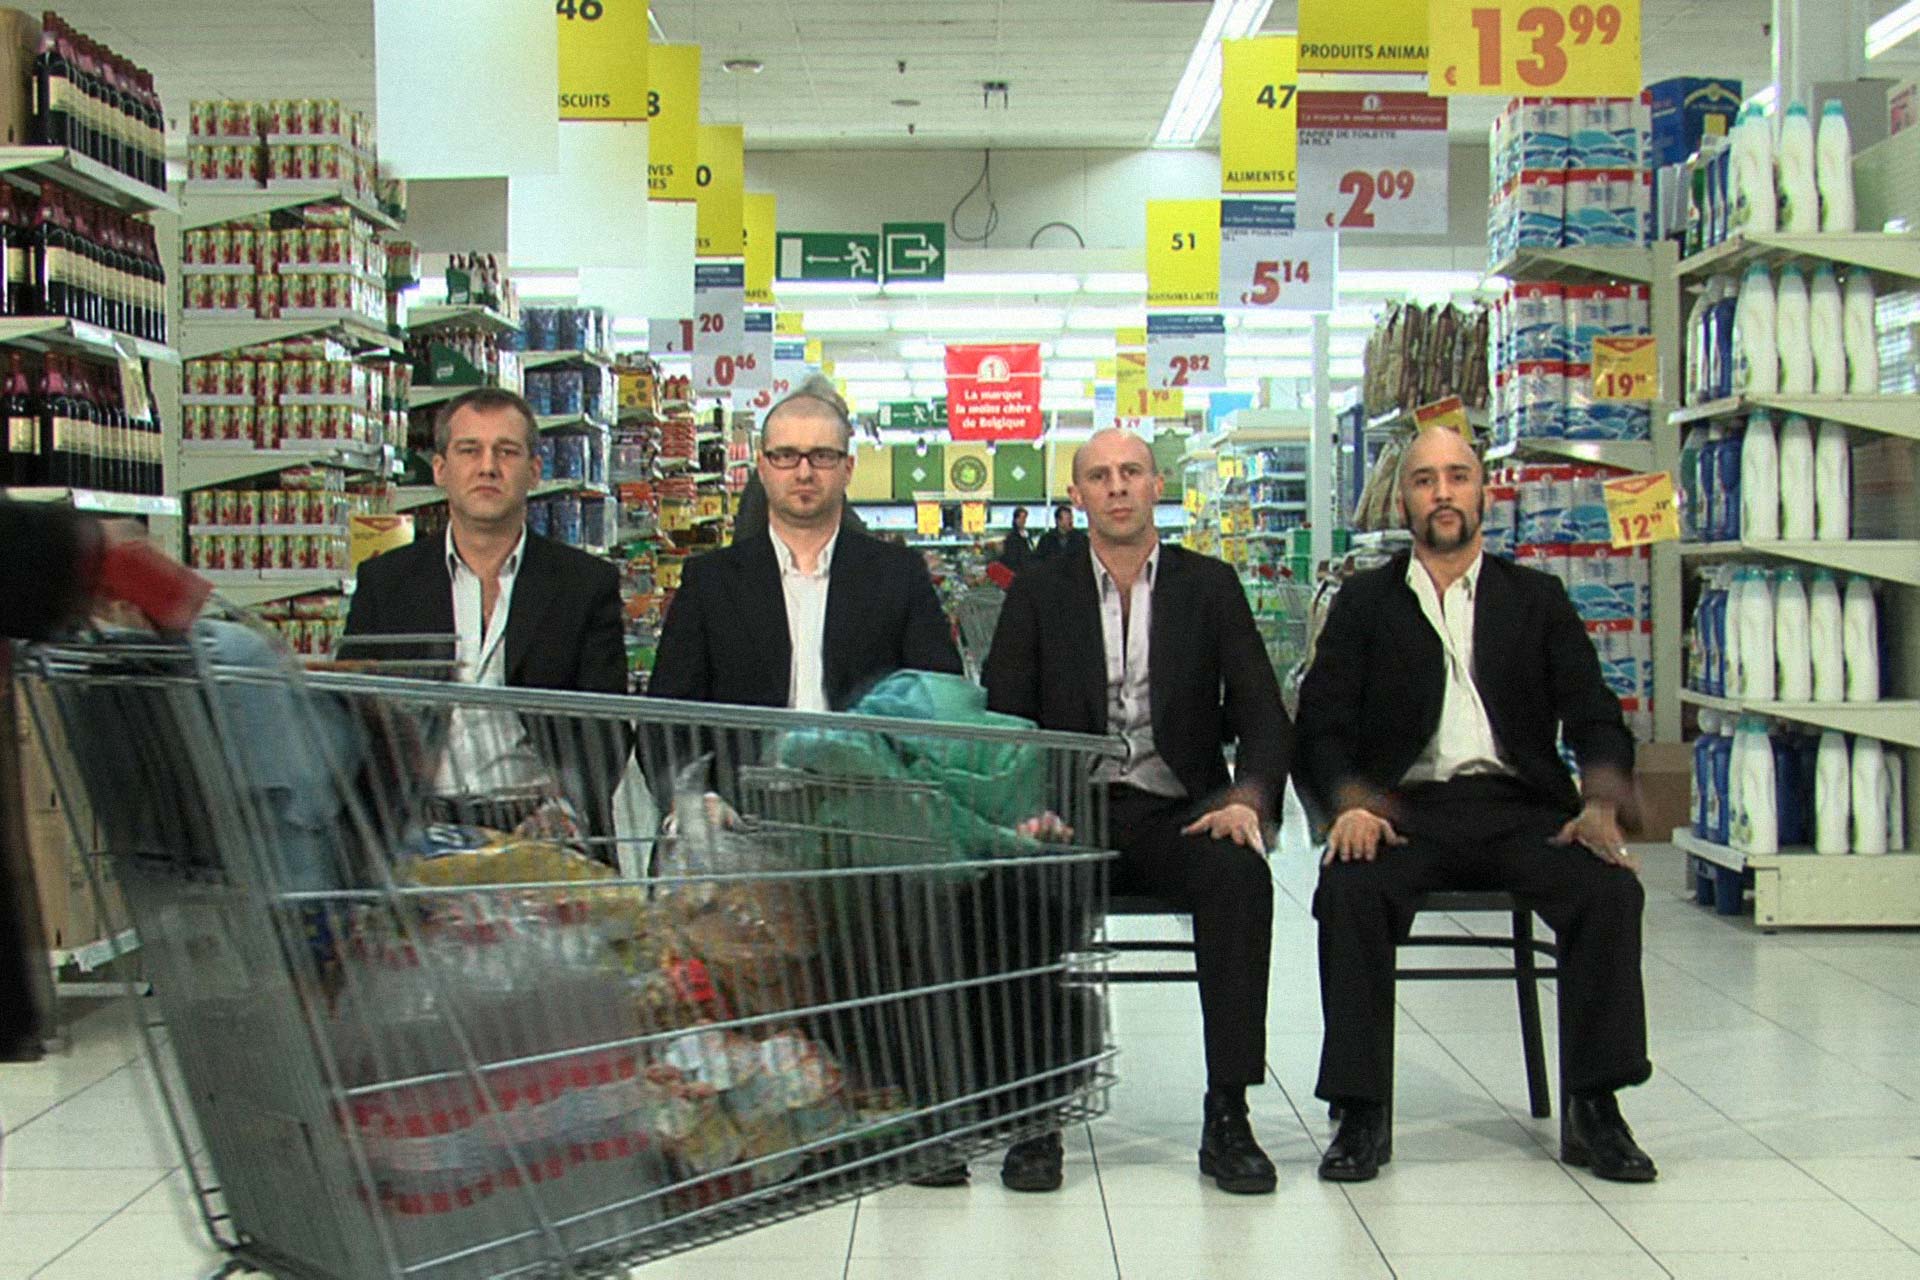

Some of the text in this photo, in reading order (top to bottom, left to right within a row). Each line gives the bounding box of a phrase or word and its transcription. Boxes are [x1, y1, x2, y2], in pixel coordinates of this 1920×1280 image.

[1300, 43, 1374, 58] PRODUITS
[1256, 84, 1297, 109] 47
[1227, 171, 1285, 182] ALIMENTS
[1171, 233, 1195, 250] 51
[979, 417, 1027, 431] Belgique
